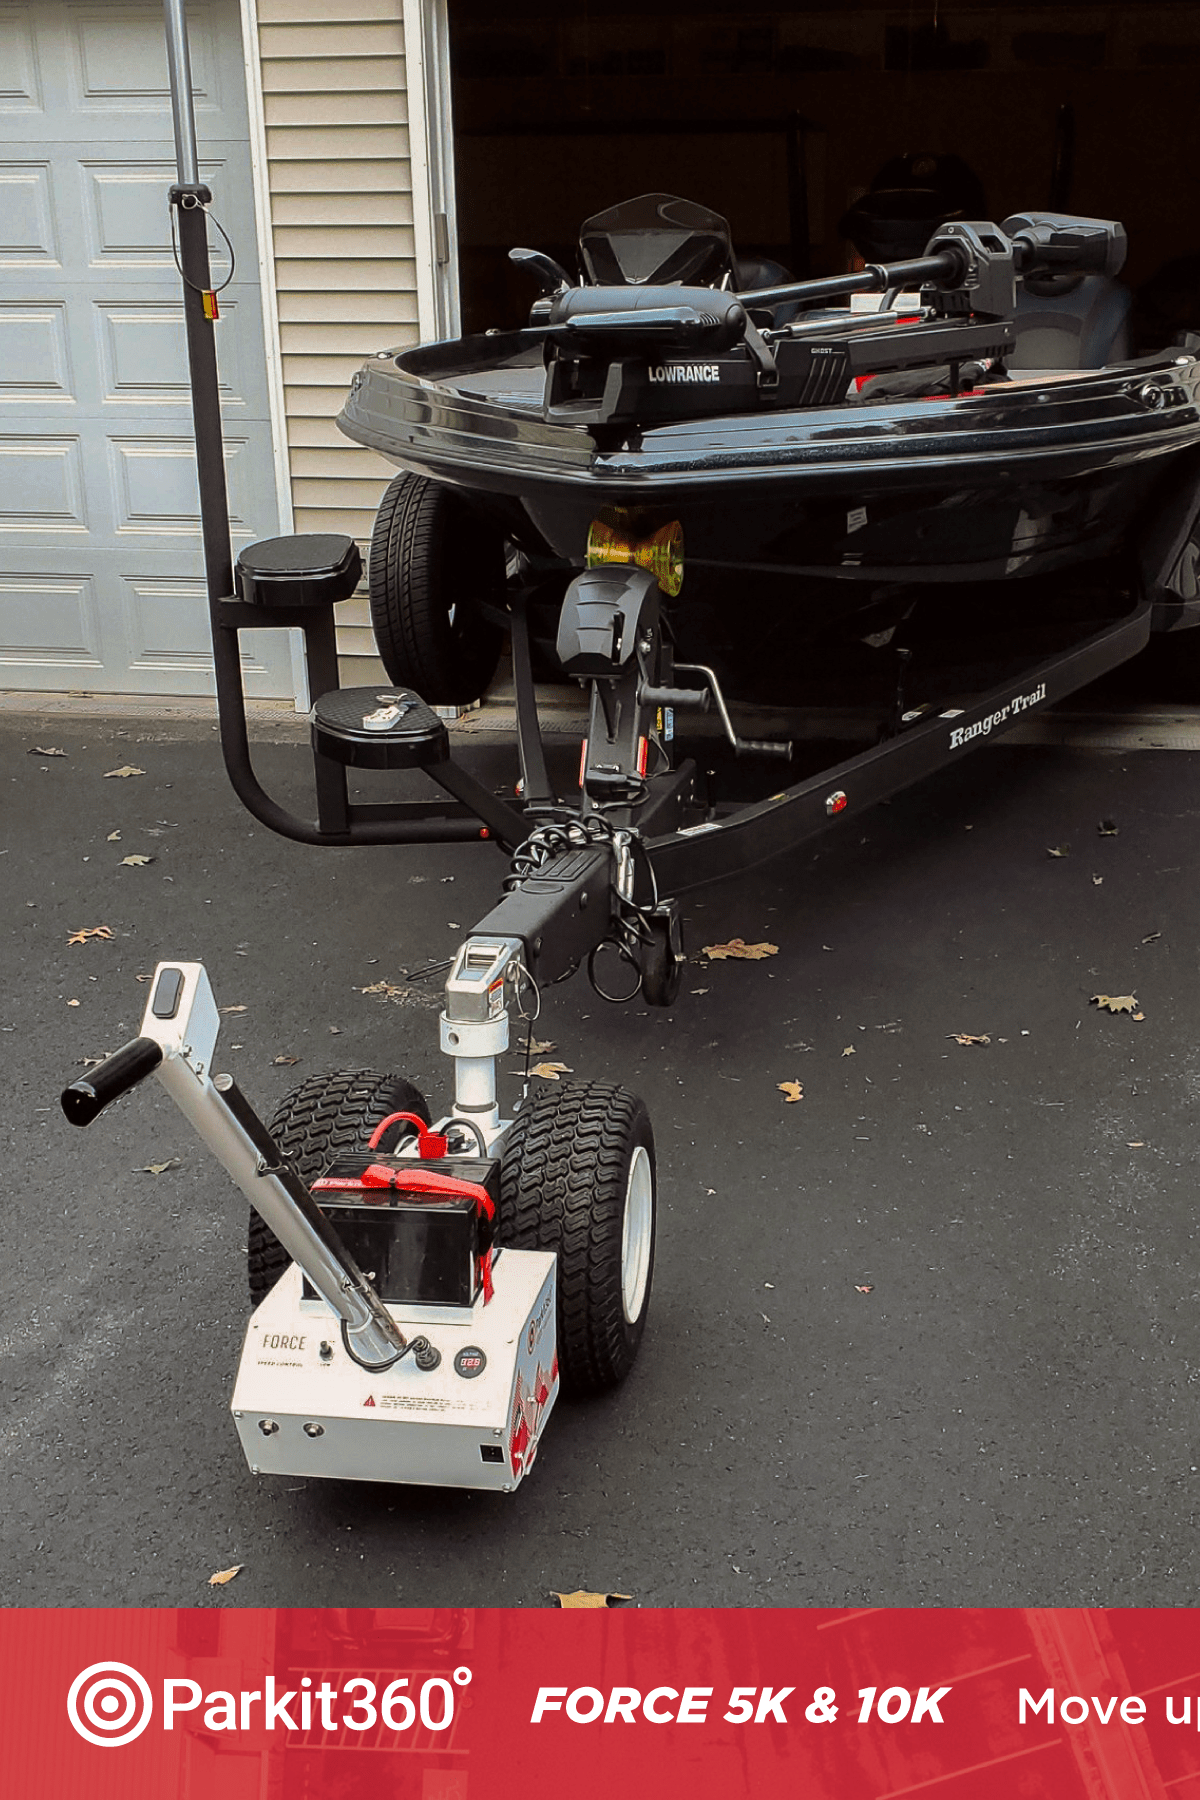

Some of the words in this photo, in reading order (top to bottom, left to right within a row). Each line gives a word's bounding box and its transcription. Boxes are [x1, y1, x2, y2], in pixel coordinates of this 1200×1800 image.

[648, 365, 720, 383] LOWRANCE
[949, 705, 1010, 750] Ranger
[1011, 683, 1047, 715] Trail
[262, 1334, 307, 1350] FORCE
